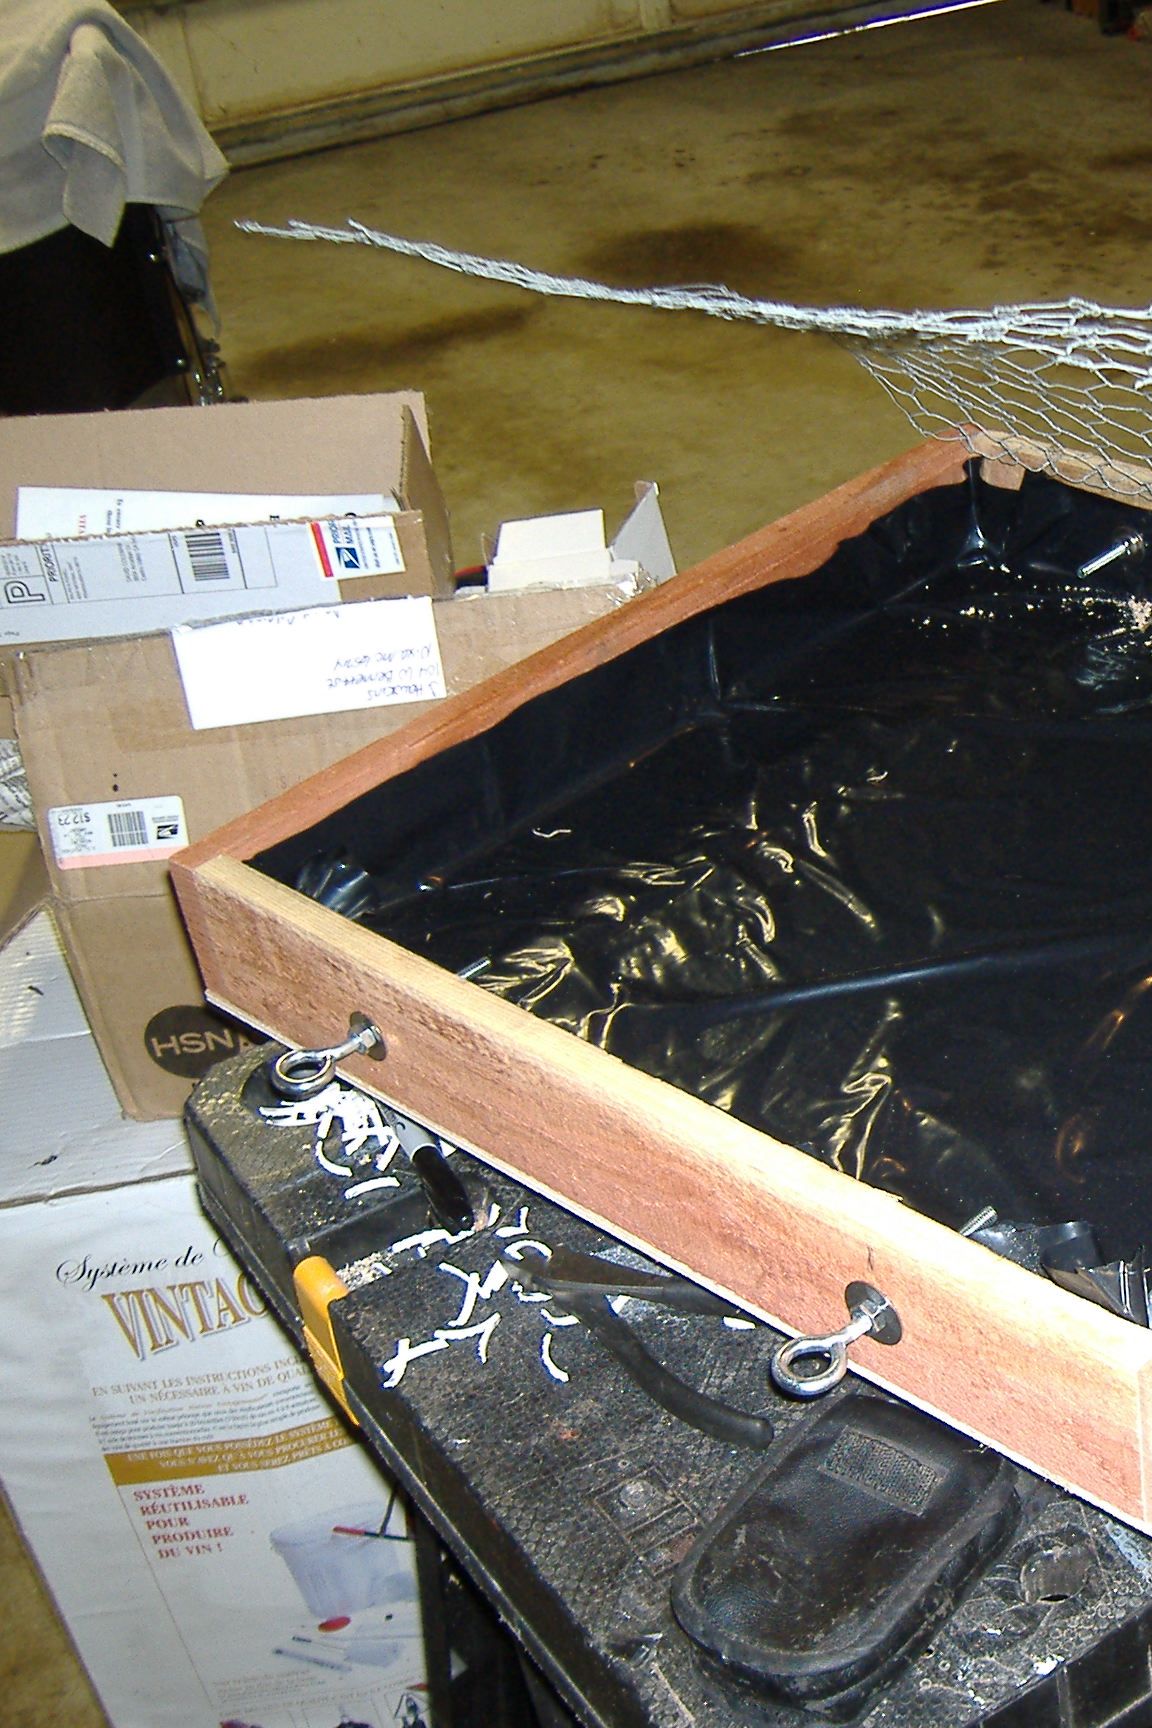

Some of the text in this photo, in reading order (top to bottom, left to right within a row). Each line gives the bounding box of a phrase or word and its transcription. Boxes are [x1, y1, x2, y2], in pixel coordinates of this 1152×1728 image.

[40, 543, 59, 582] PRIORIT
[4, 581, 46, 604] P
[151, 1029, 234, 1057] HSN
[56, 1255, 169, 1292] Système
[174, 1245, 205, 1268] de
[186, 1363, 271, 1386] INSTRUCTIONS
[257, 1376, 276, 1389] DE
[133, 1484, 205, 1501] SYSTÈME
[140, 1494, 249, 1516] RÉUTILISABLE
[146, 1517, 189, 1530] POUR
[152, 1527, 234, 1545] PRODUIRE
[159, 1548, 180, 1559] DU
[186, 1544, 212, 1555] VIN
